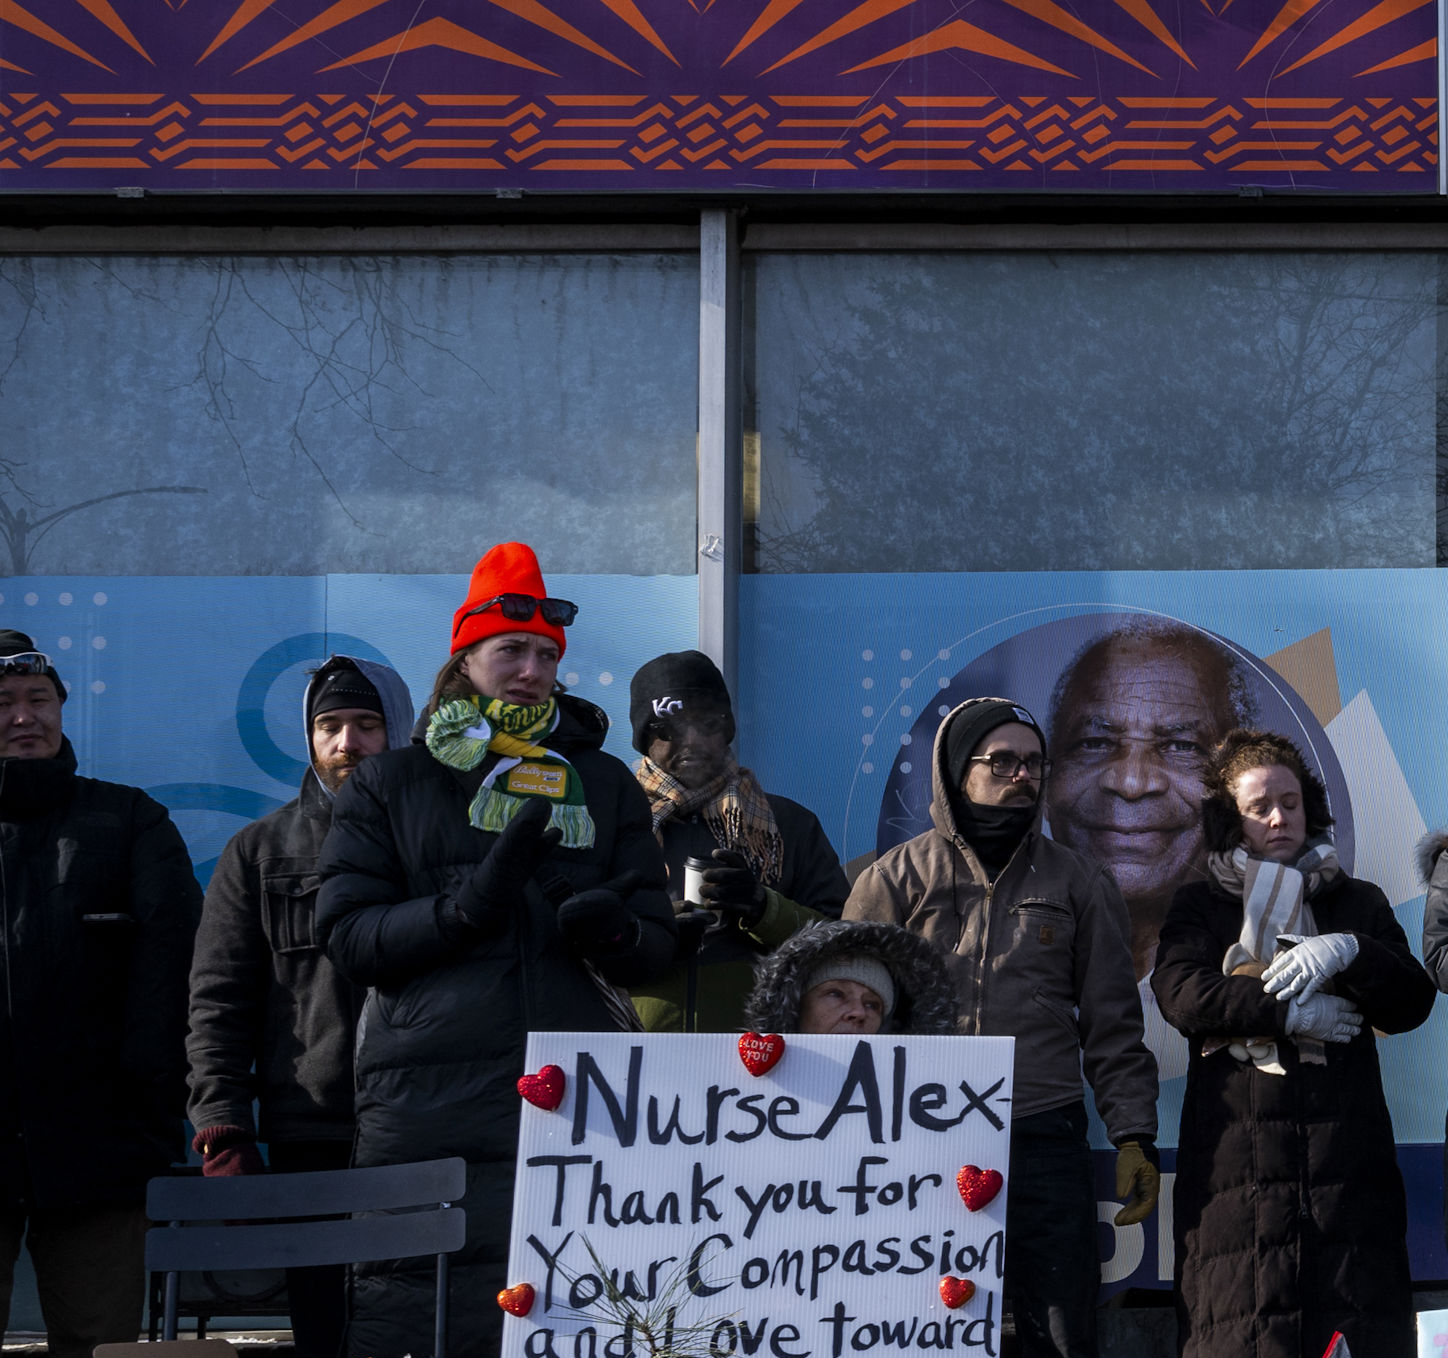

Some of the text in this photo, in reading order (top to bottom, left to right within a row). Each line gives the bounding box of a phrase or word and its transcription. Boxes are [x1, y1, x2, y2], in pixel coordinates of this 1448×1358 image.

[652, 696, 683, 718] KC
[745, 1039, 774, 1052] LOVE
[747, 1050, 769, 1062] YOU
[571, 1040, 1012, 1148] Nurse Alex
[526, 1154, 725, 1227] Thank
[734, 1178, 838, 1238] you
[525, 1231, 1004, 1314] Your Compassion
[819, 1291, 998, 1358] toward
